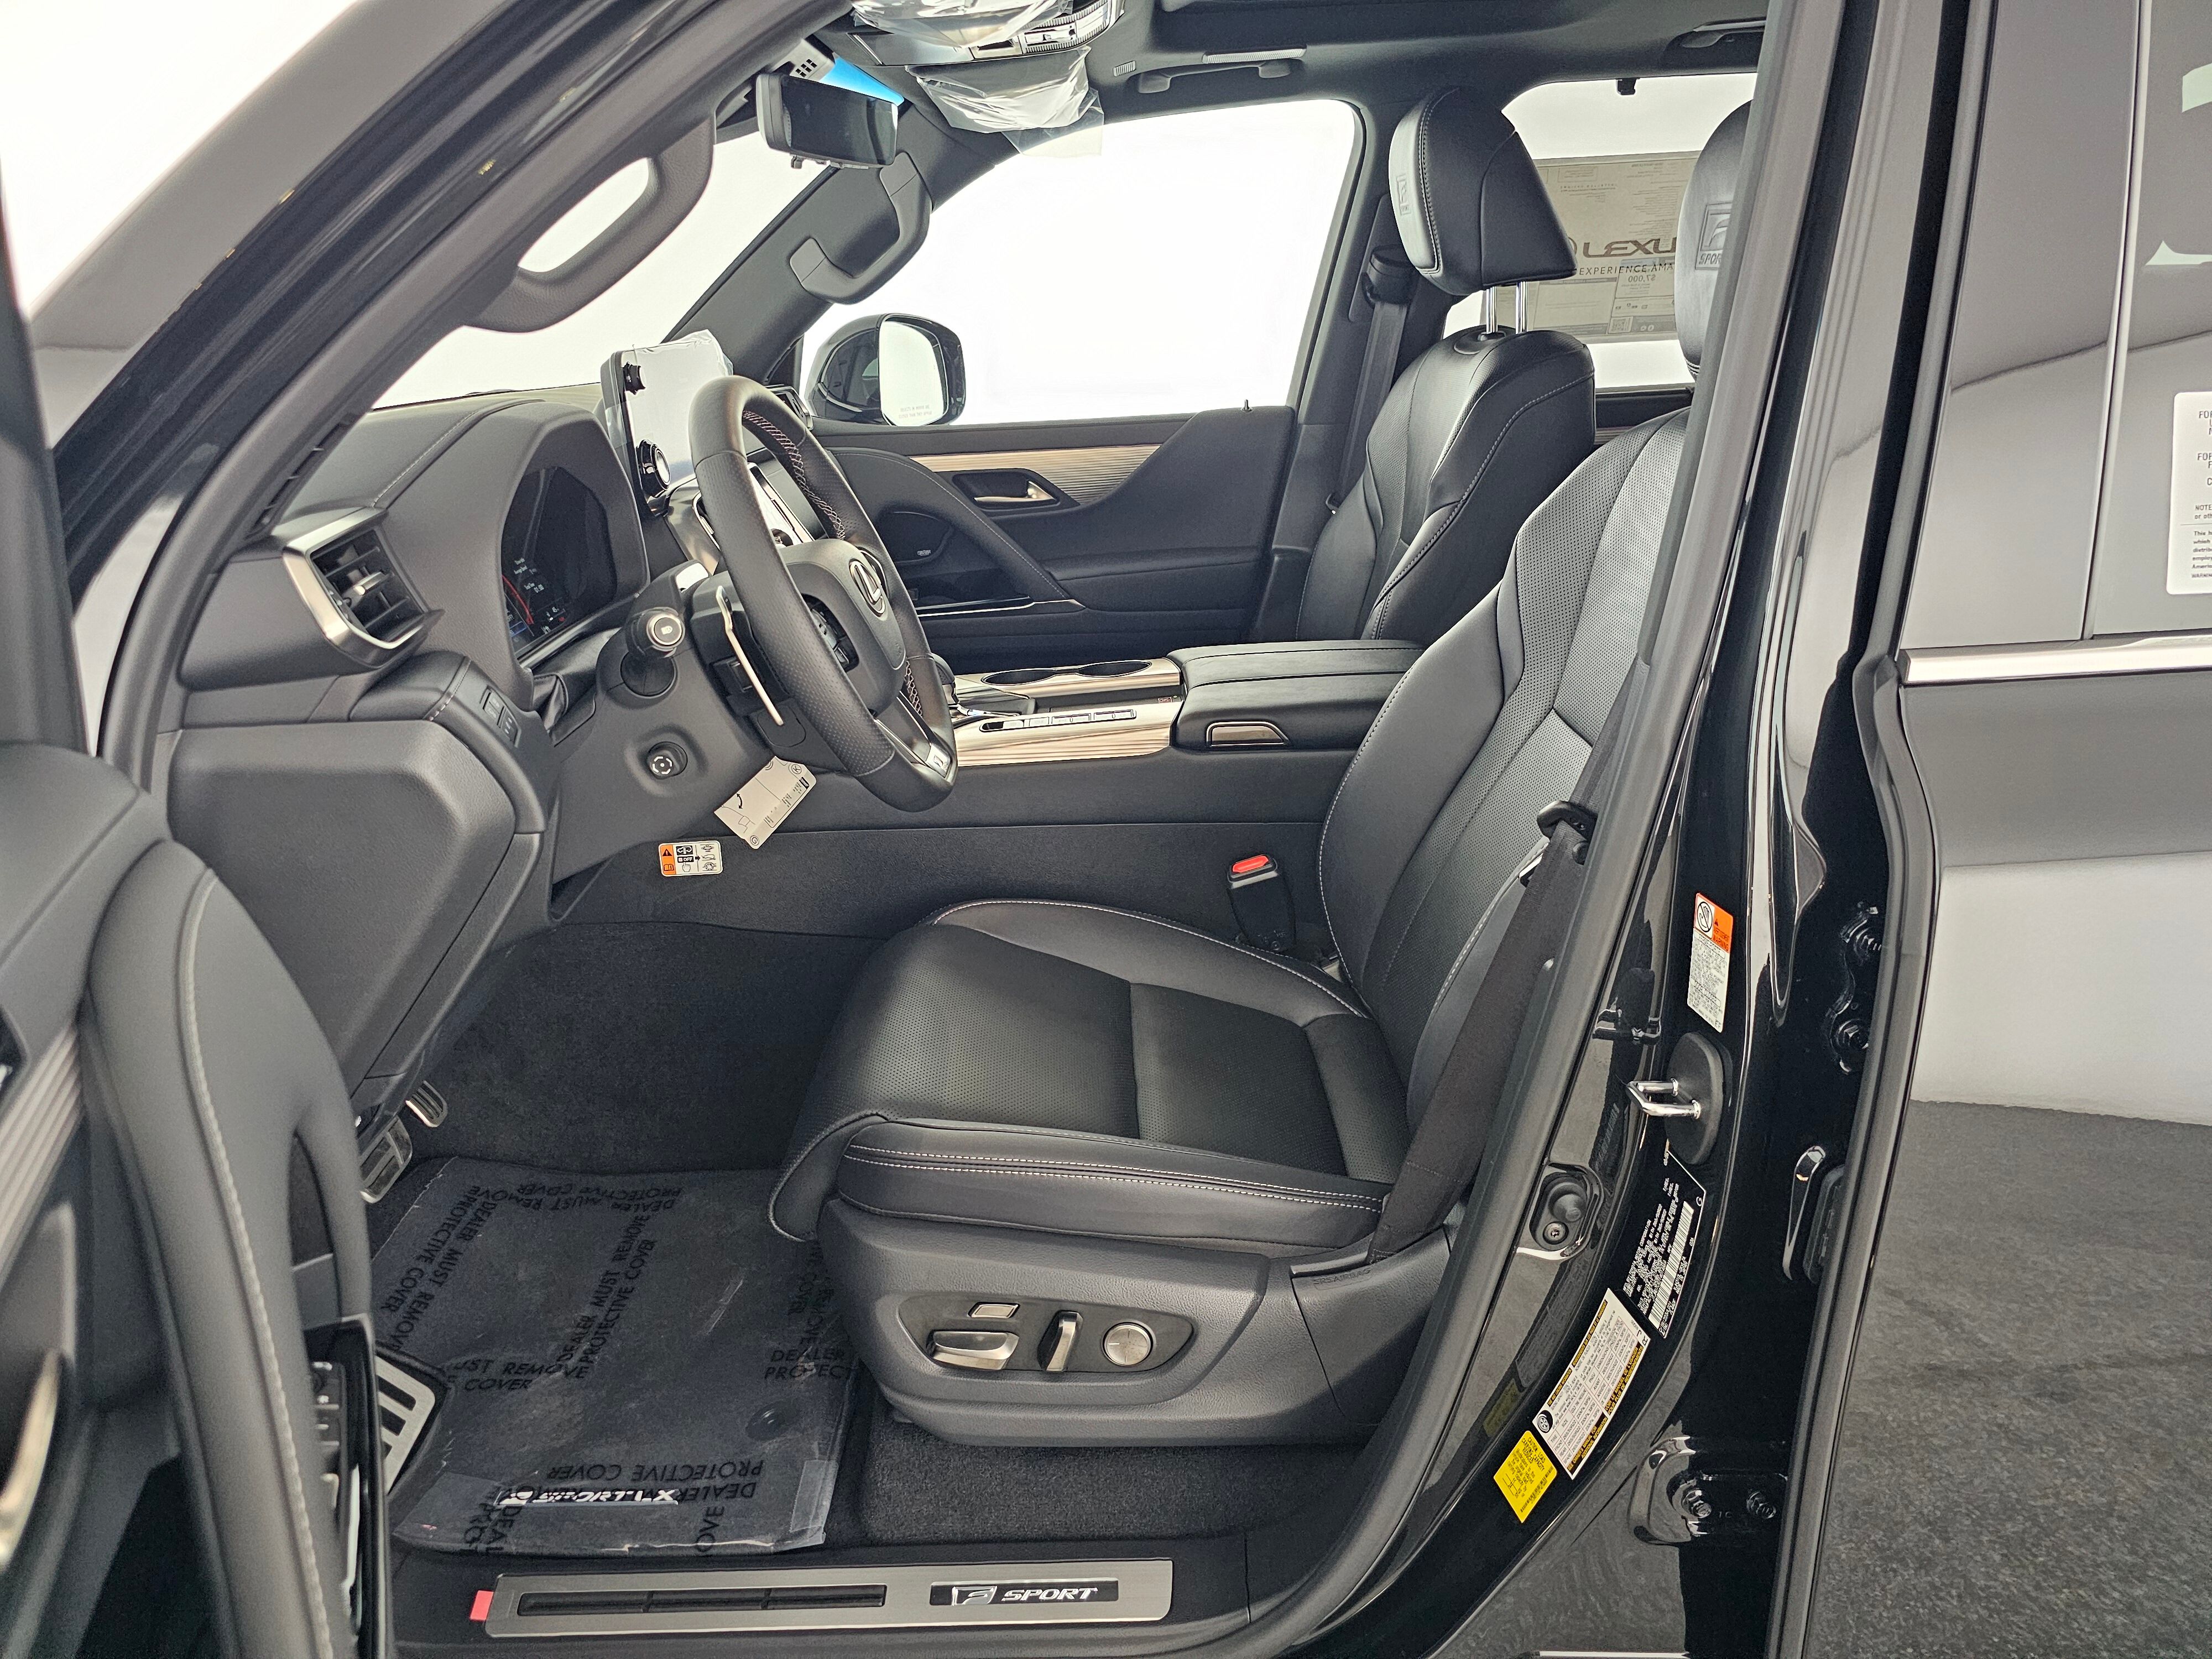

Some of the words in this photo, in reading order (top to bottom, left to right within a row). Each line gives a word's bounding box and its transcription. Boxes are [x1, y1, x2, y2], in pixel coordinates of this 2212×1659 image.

[1583, 237, 1676, 258] LEXU
[1579, 264, 1647, 275] EXPERIENCE
[1651, 263, 1673, 272] AMA
[1698, 253, 1721, 264] SPOR
[457, 1201, 497, 1241] DEALER
[429, 1248, 463, 1287] MUST
[382, 1266, 425, 1313] COVER
[556, 1314, 596, 1363] DEALER
[589, 1269, 620, 1309] MUST
[613, 1214, 651, 1263] REMOVE
[578, 1285, 635, 1365] PROTECTIVE
[627, 1239, 656, 1281] COVER
[451, 1359, 494, 1374] UST
[503, 1361, 590, 1380] REMOVE
[465, 1378, 533, 1391] COVER
[546, 1464, 621, 1480] COVER
[632, 1460, 764, 1480] PROTECTIVE
[487, 1505, 523, 1550] DEAL
[695, 1507, 725, 1553] OVE
[1001, 1587, 1099, 1602] SPORT
